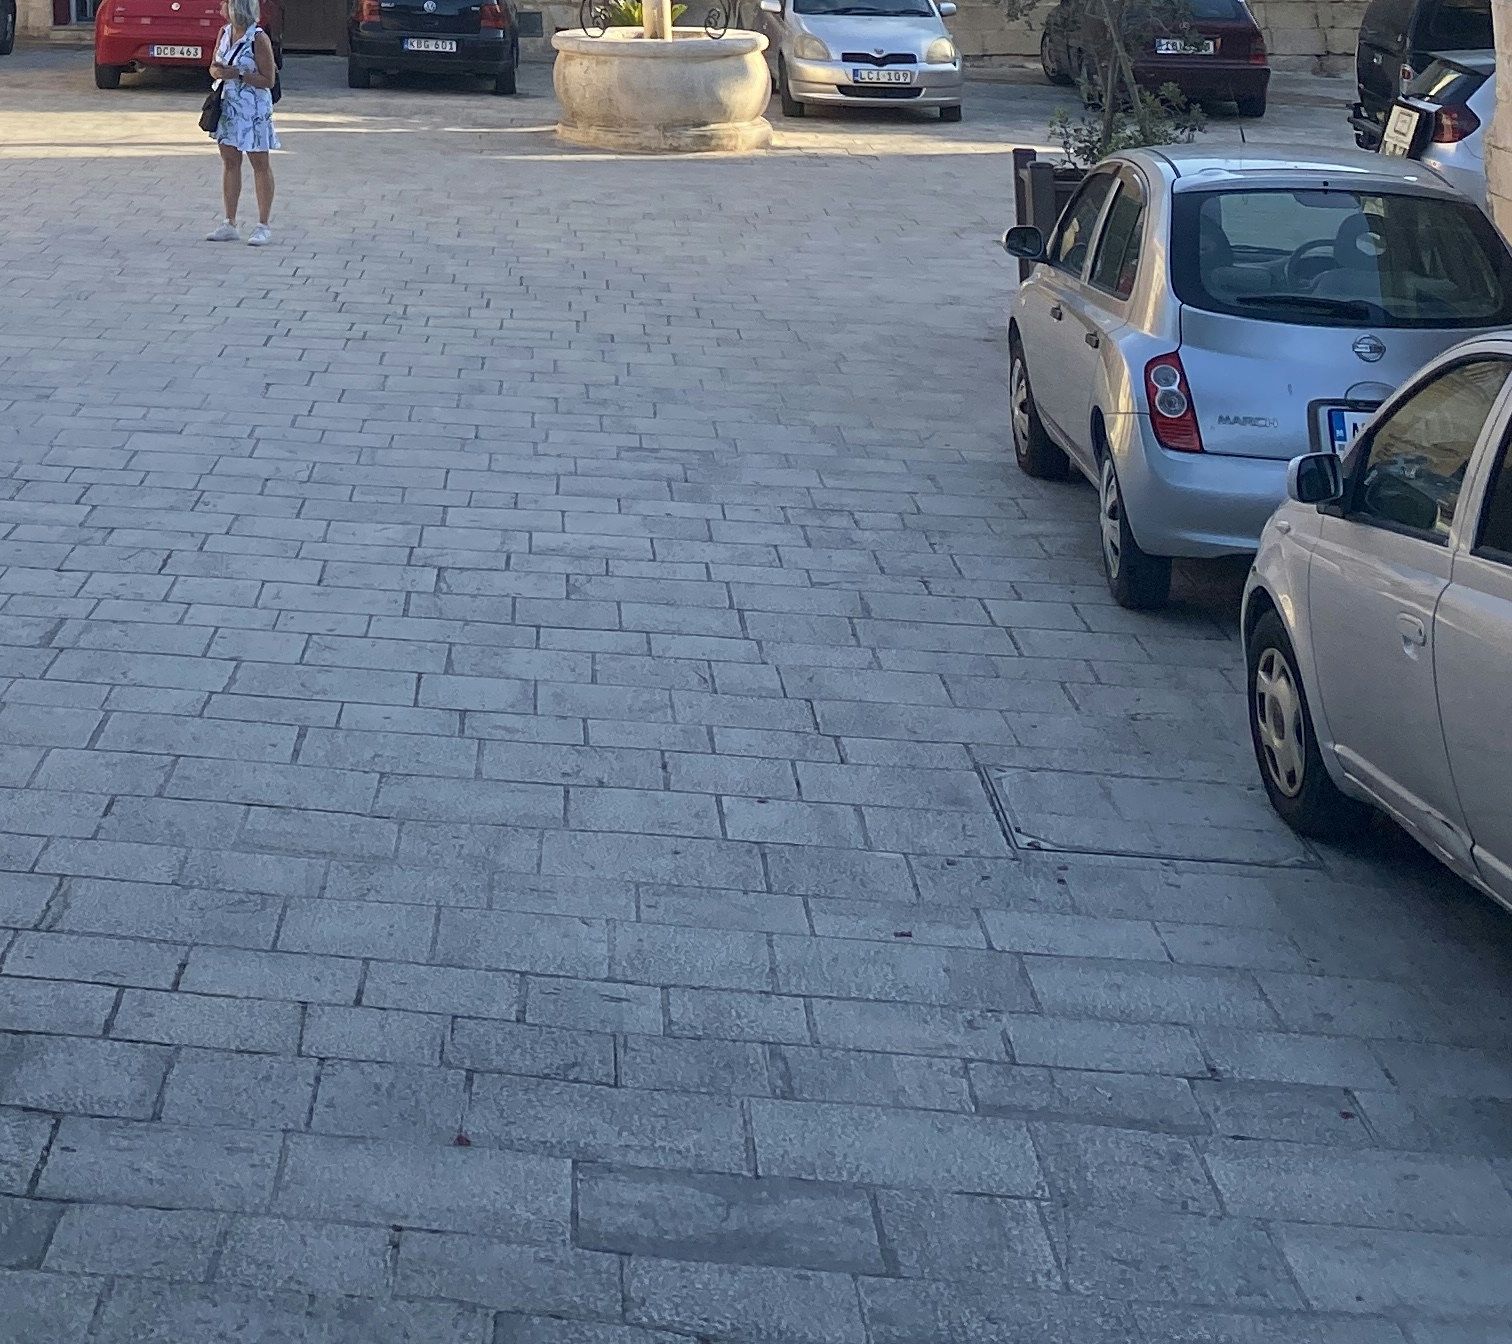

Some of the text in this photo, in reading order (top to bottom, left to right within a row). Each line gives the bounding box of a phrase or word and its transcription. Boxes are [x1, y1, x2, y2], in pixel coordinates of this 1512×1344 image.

[409, 39, 454, 51] KBG 601
[156, 46, 199, 57] DCB 463
[887, 71, 909, 82] 109
[1217, 415, 1279, 428] MARCH
